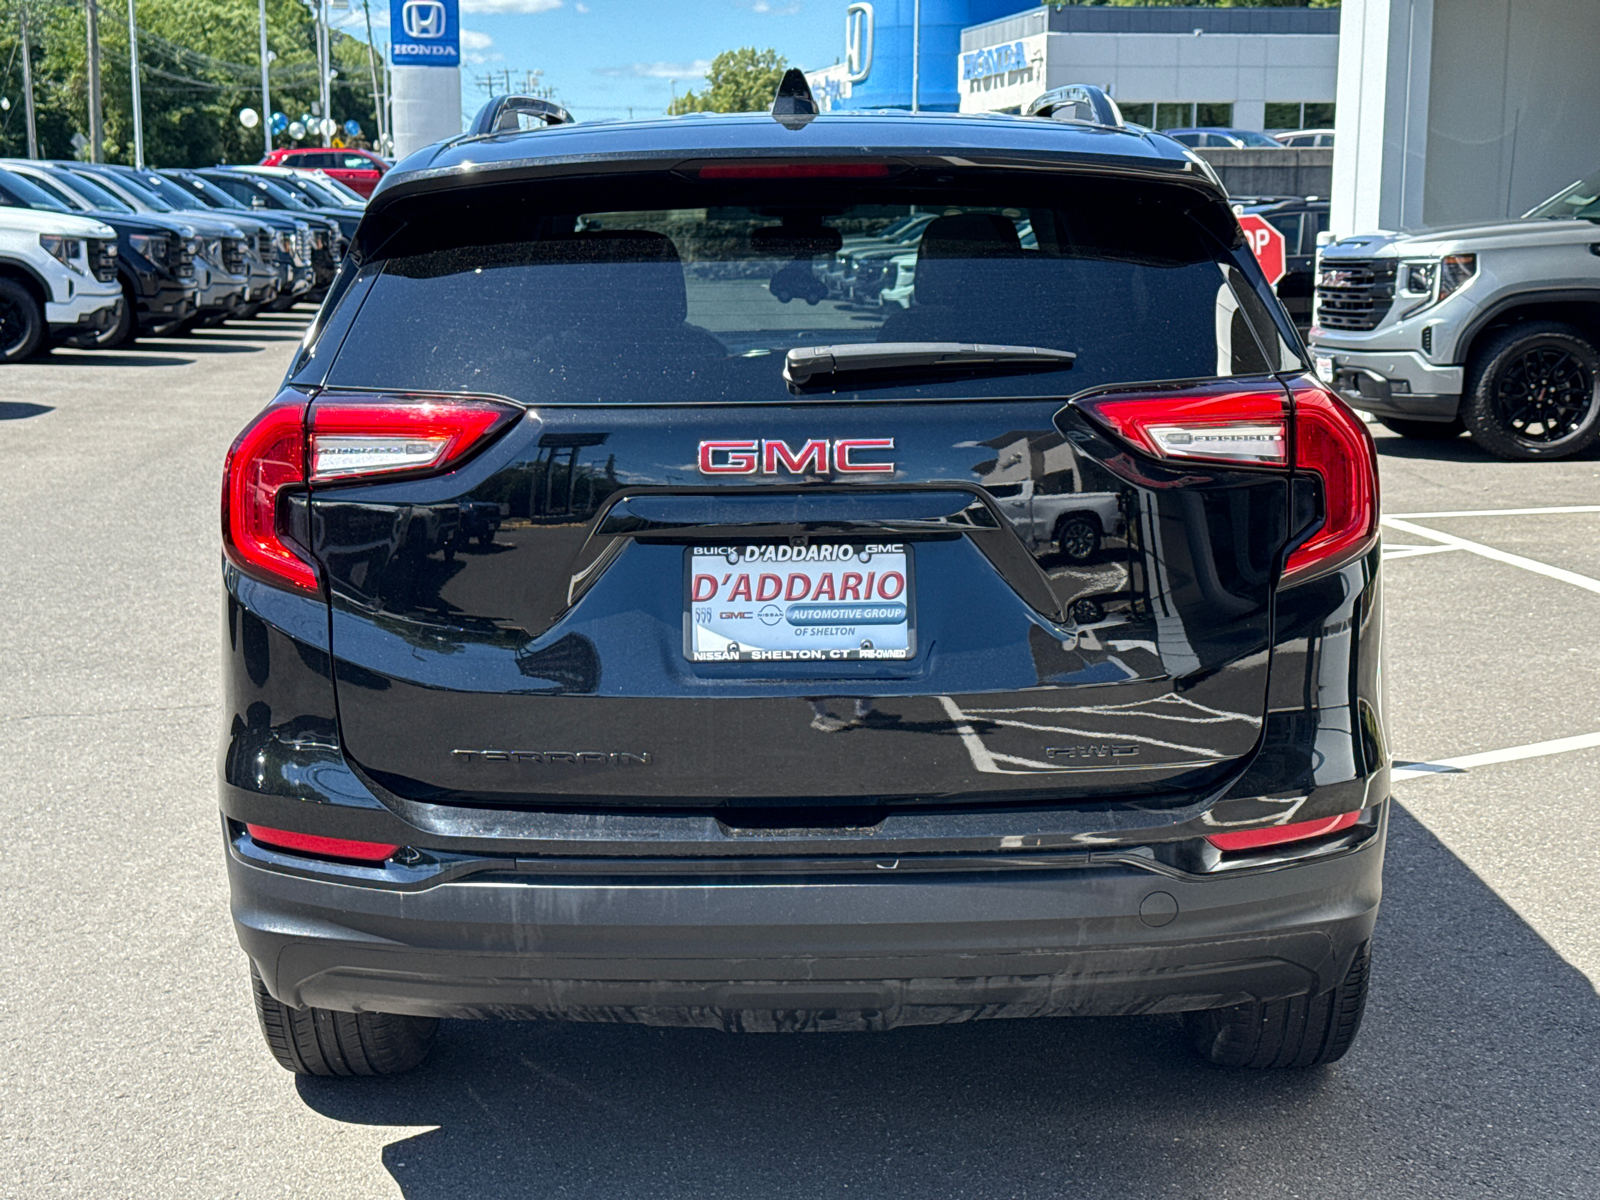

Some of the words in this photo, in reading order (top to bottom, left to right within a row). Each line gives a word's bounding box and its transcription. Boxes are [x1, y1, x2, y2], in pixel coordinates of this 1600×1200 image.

[394, 44, 457, 55] HONDA
[962, 41, 1027, 80] HONDA
[698, 438, 895, 475] GMC
[693, 546, 738, 556] BUICK
[743, 544, 854, 563] D'ADDARIO
[864, 543, 904, 554] GMC
[691, 570, 905, 602] D'ADDARIO
[719, 611, 754, 620] GMC
[792, 608, 862, 620] AUTOMOTIVE
[863, 608, 902, 619] GROUP
[794, 627, 809, 637] OF
[810, 627, 856, 637] SHELTON
[694, 650, 739, 661] NISSAN
[751, 649, 826, 660] SHELTON,
[829, 649, 851, 659] CT
[450, 749, 652, 764] TERRAIN
